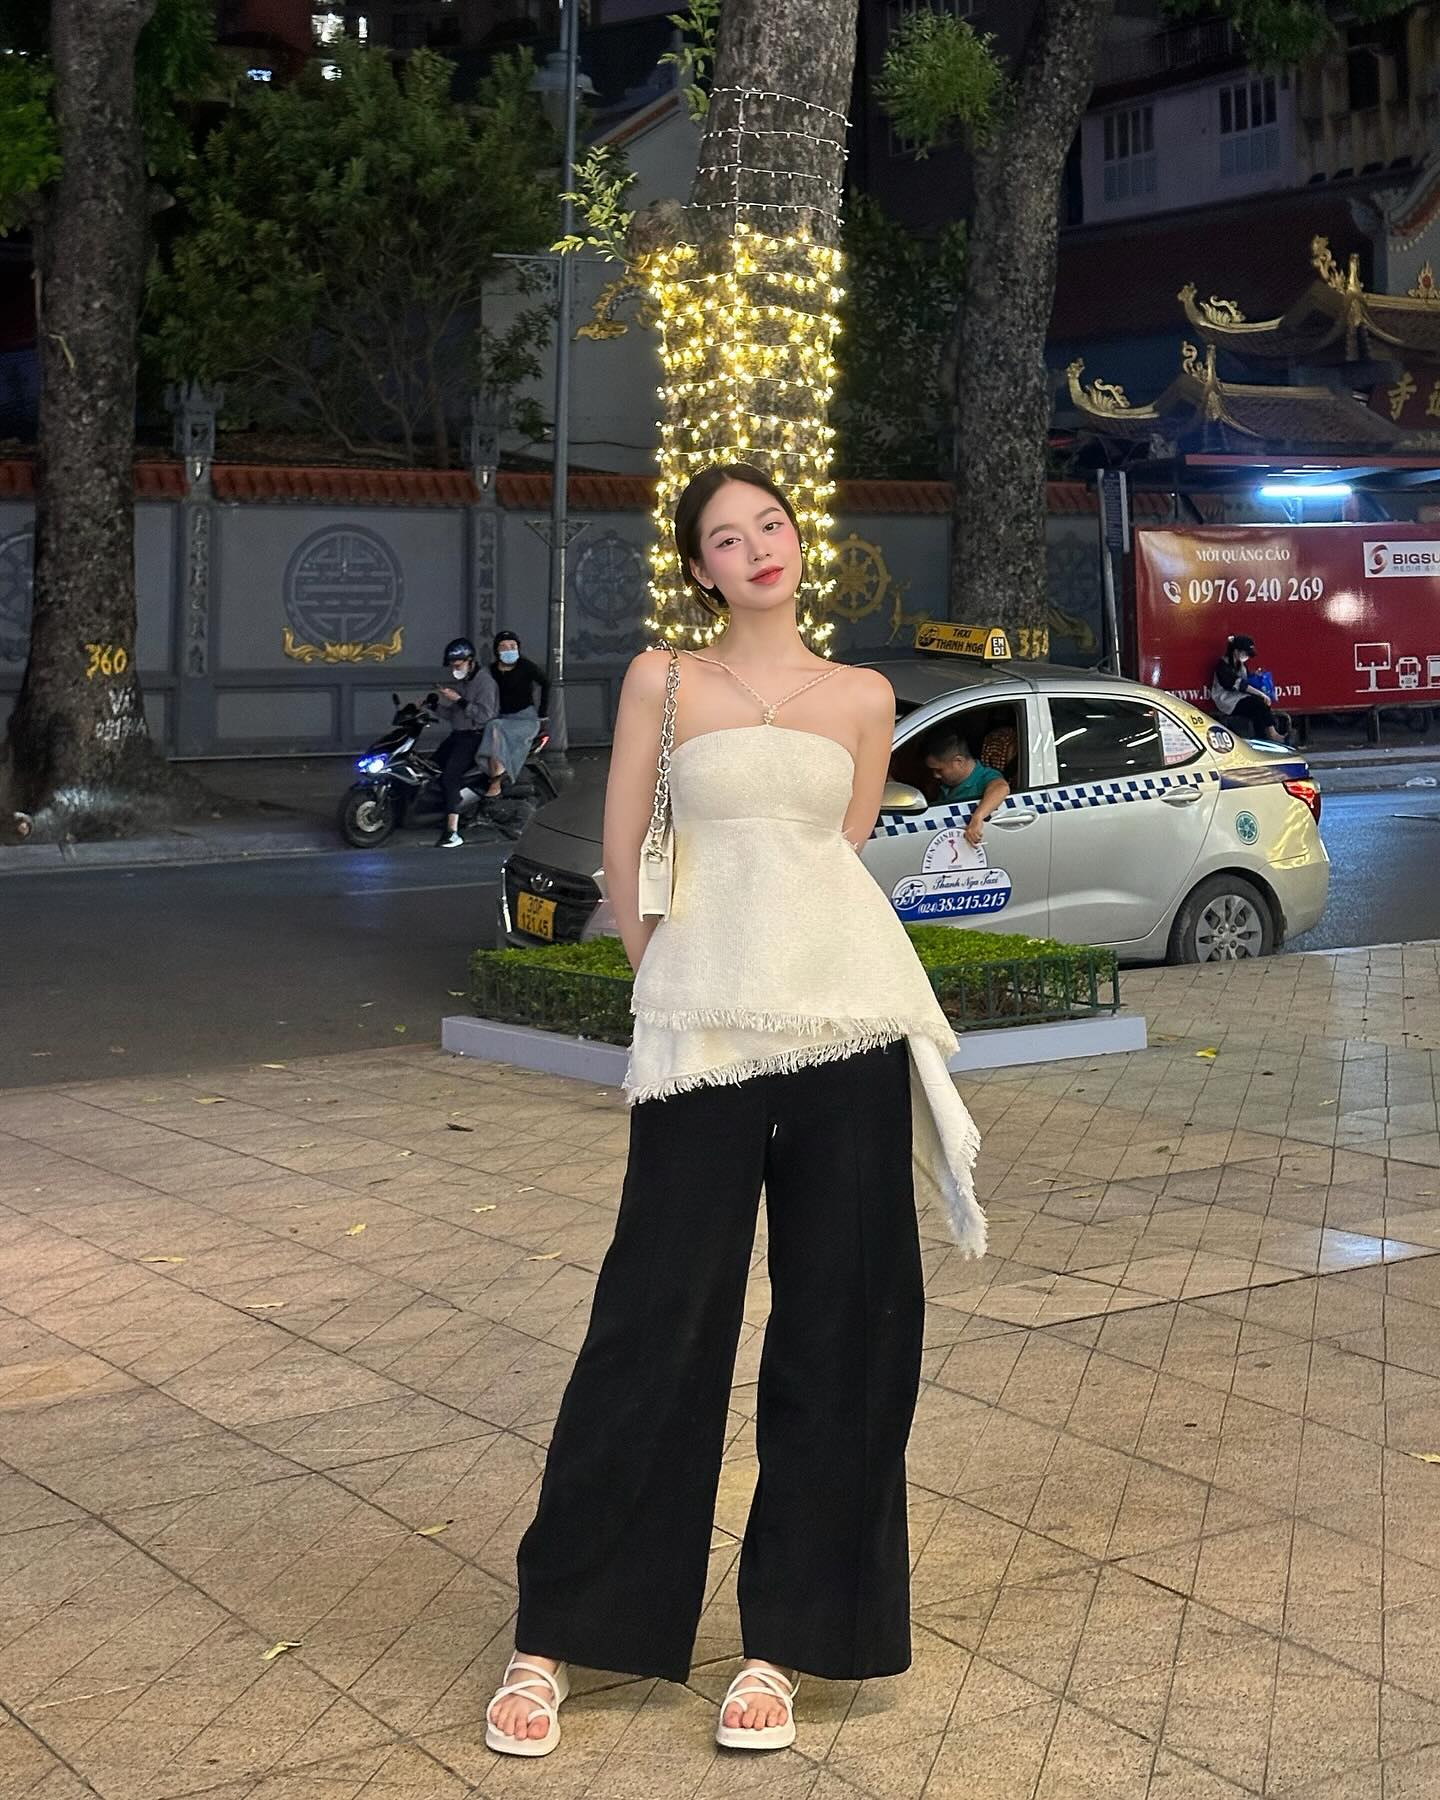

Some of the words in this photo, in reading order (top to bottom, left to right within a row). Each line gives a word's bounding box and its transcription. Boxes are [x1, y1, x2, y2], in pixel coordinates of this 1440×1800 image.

[1188, 579, 1239, 604] 0976
[1245, 578, 1281, 602] 240
[1288, 577, 1324, 601] 269
[952, 628, 972, 639] TAXI
[936, 638, 964, 653] THANH
[965, 641, 984, 654] NGA
[84, 644, 128, 680] 360
[1191, 715, 1205, 726] be
[932, 875, 960, 890] Thanh
[961, 877, 979, 890] Nga
[980, 871, 999, 887] Taxi
